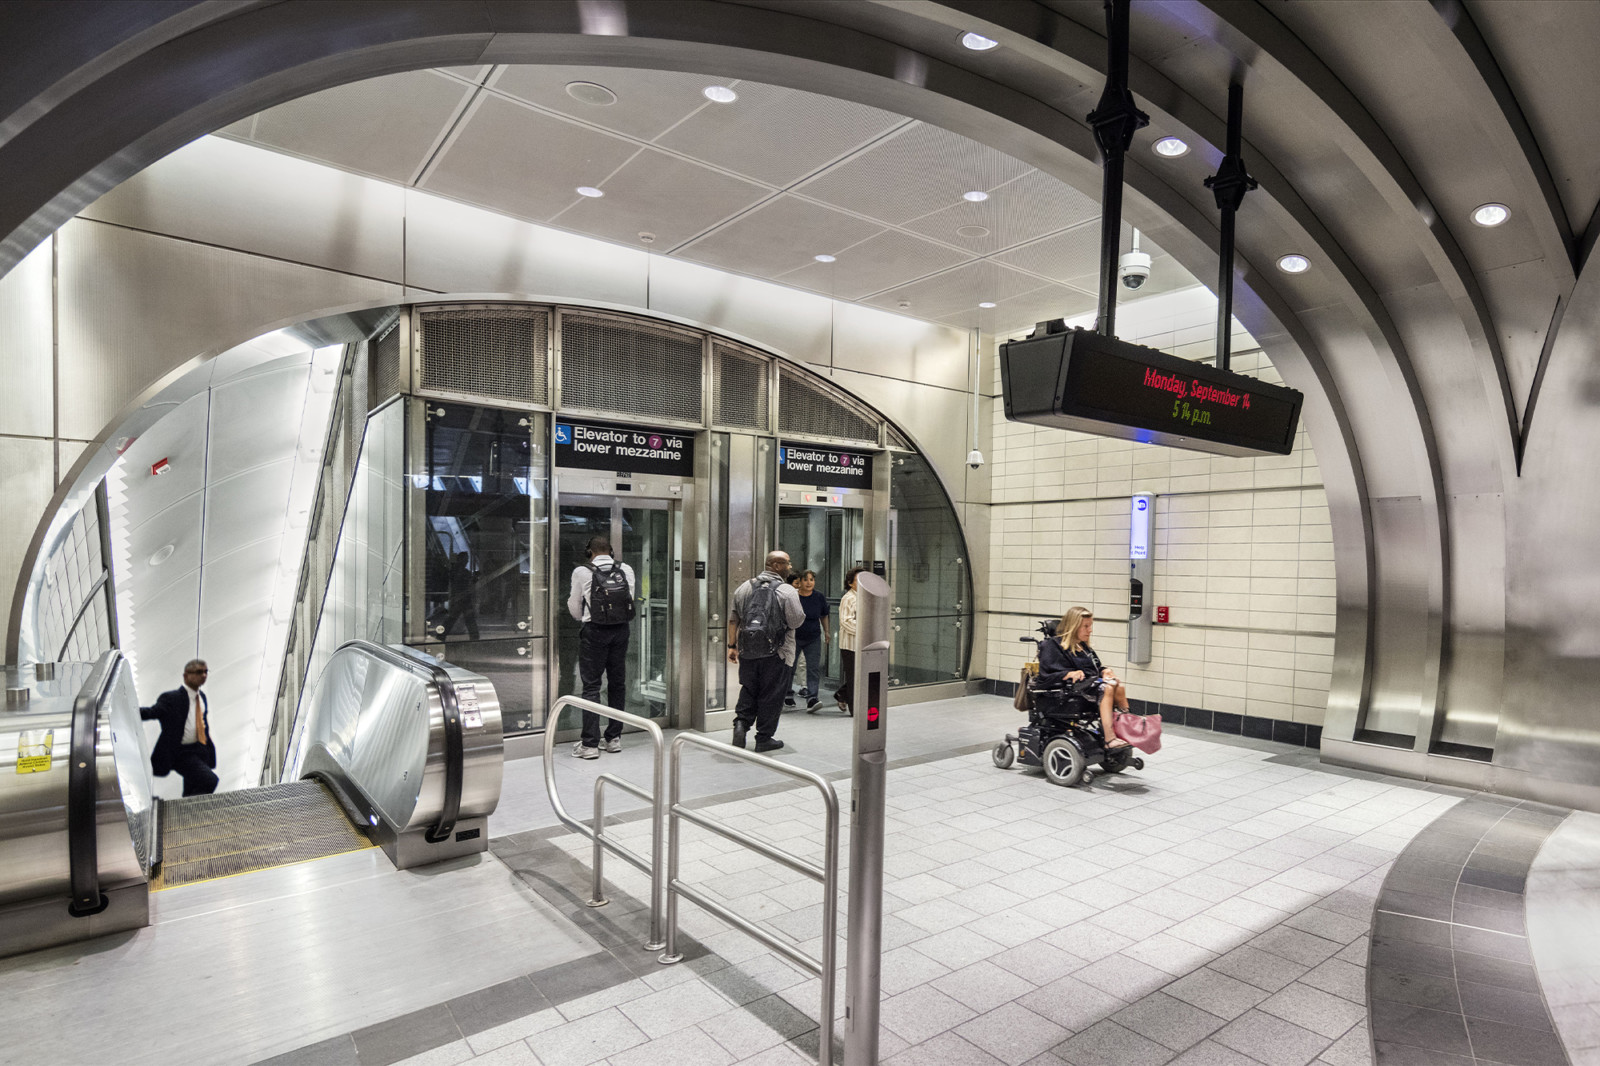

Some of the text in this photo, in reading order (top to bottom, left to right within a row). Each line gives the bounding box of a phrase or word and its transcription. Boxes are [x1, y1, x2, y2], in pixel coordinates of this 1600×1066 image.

[1143, 367, 1251, 410] Monday, September 14
[1191, 408, 1212, 426] p.m.
[573, 426, 628, 443] Elevator
[633, 433, 647, 445] to
[665, 437, 683, 448] via
[573, 439, 682, 460] lower mezzanine
[786, 448, 825, 462] Elevator
[828, 453, 839, 463] to
[852, 456, 865, 466] via
[786, 460, 864, 476] lower mezzanine
